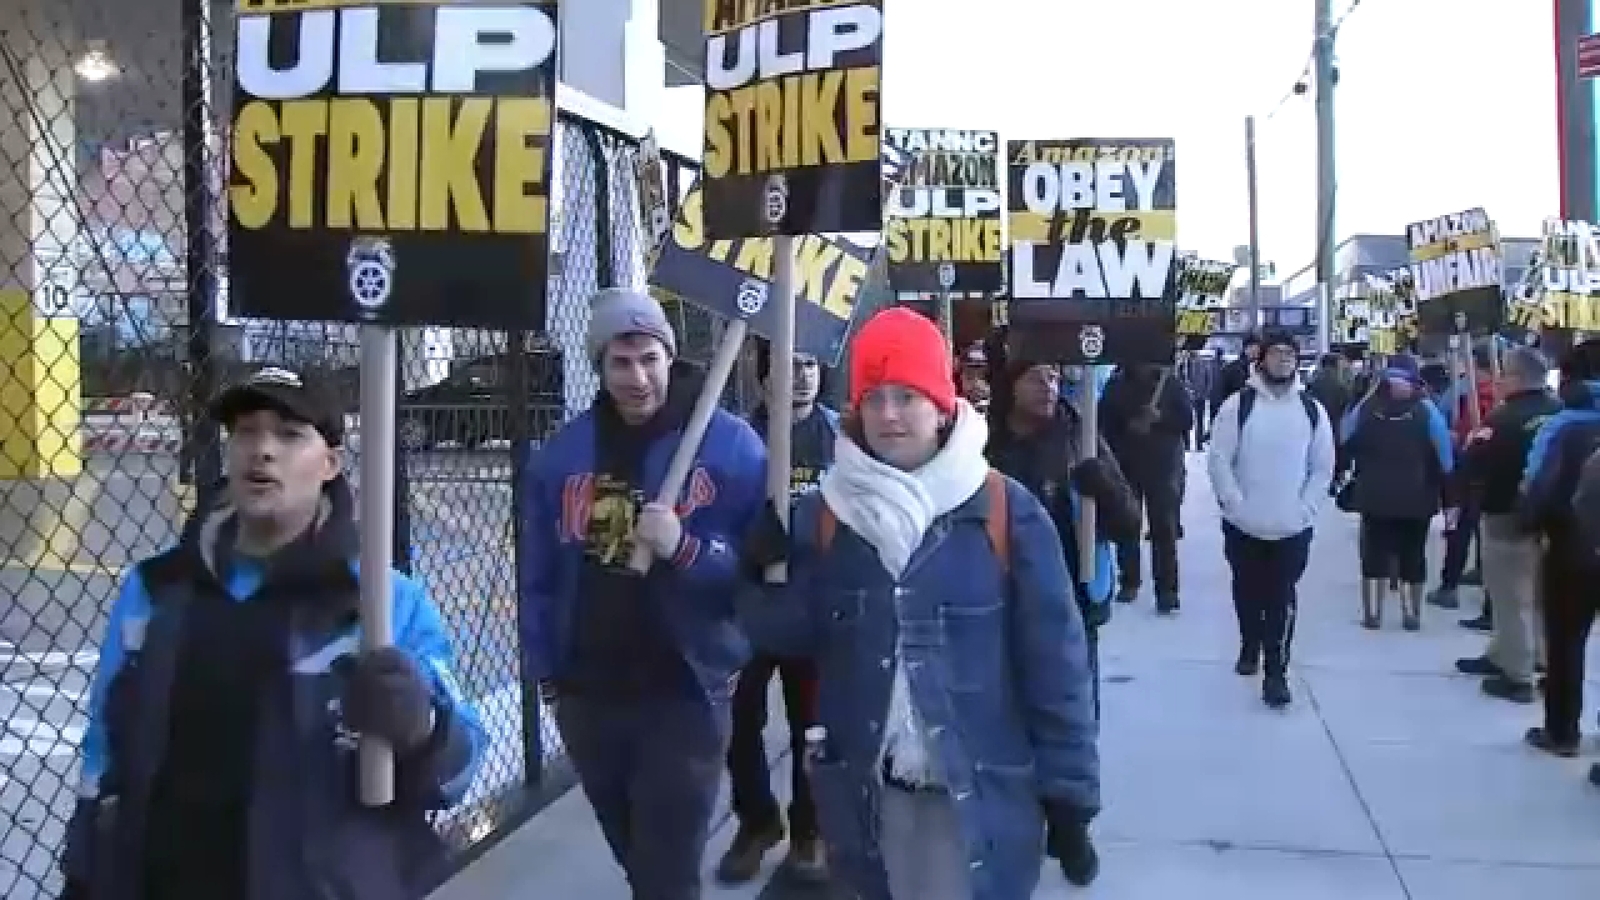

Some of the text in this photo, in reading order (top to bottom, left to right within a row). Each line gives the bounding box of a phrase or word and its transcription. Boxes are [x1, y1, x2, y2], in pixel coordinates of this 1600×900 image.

[237, 6, 556, 98] ULP
[706, 5, 883, 91] ULP
[705, 66, 881, 178] STRIKE
[230, 97, 549, 233] STRIKE
[888, 187, 1001, 216] ULP
[1023, 161, 1163, 214] OBEY
[673, 188, 868, 321] SRKE
[887, 218, 1001, 264] STRIKE
[1045, 208, 1142, 245] the
[1012, 239, 1174, 299] LAW
